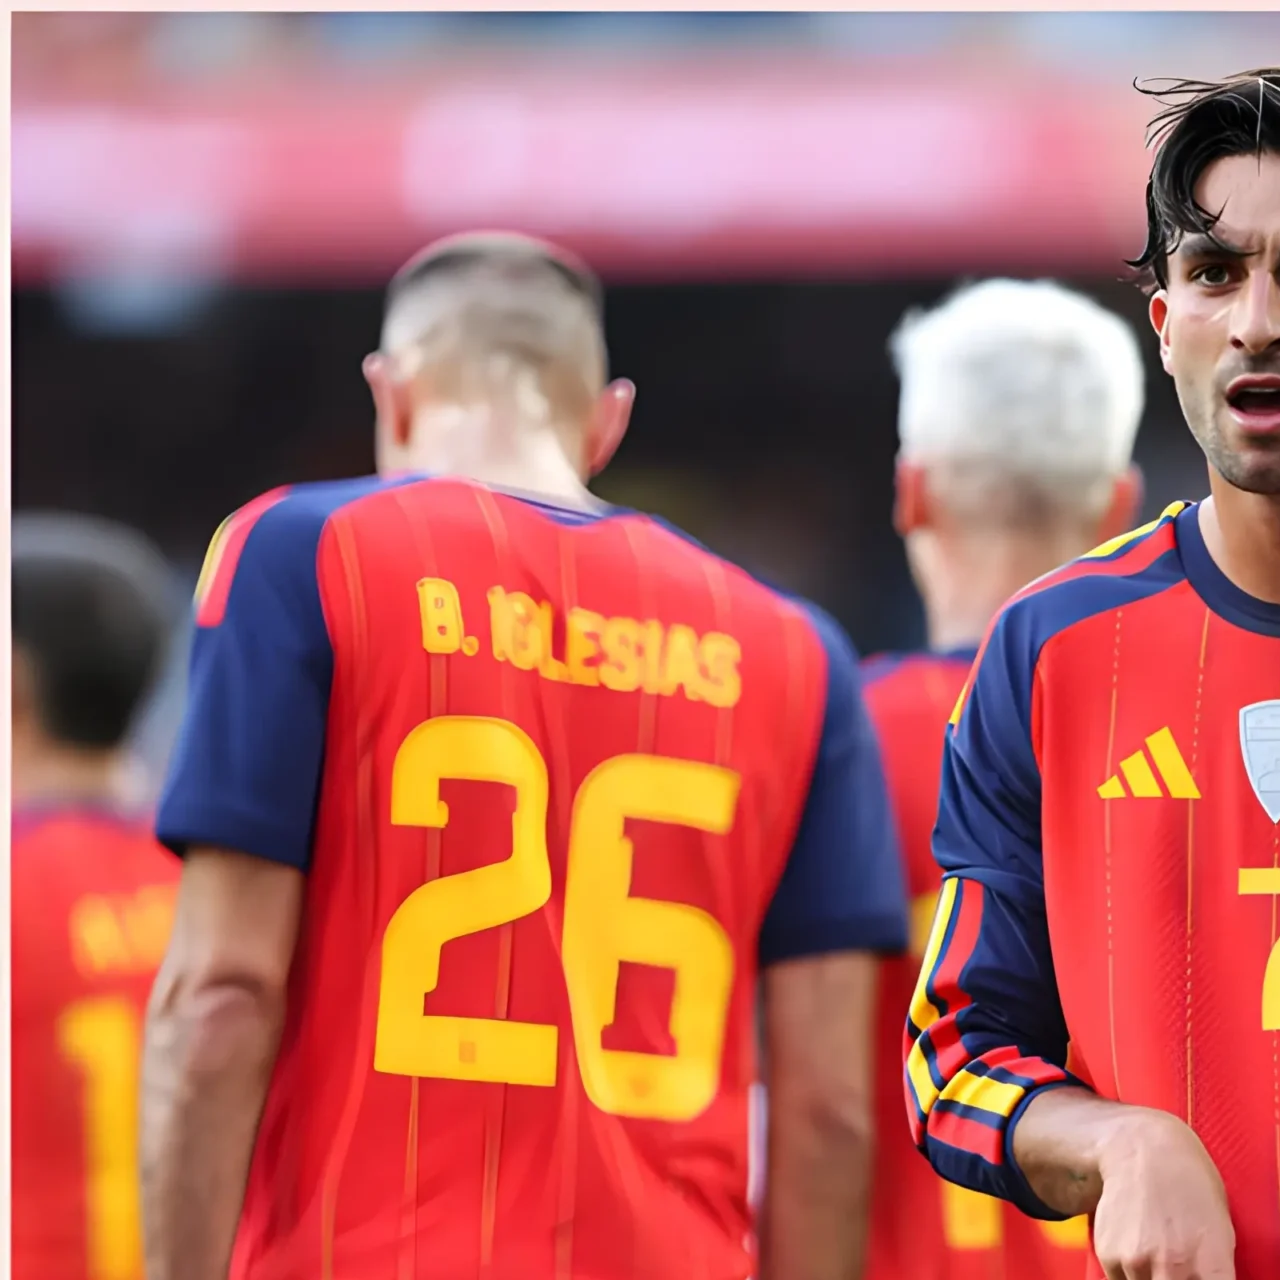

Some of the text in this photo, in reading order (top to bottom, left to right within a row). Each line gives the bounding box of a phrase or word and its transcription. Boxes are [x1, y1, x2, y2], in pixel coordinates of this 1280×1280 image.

[416, 577, 742, 708] B. IGLESIAS
[374, 715, 741, 1122] 26
